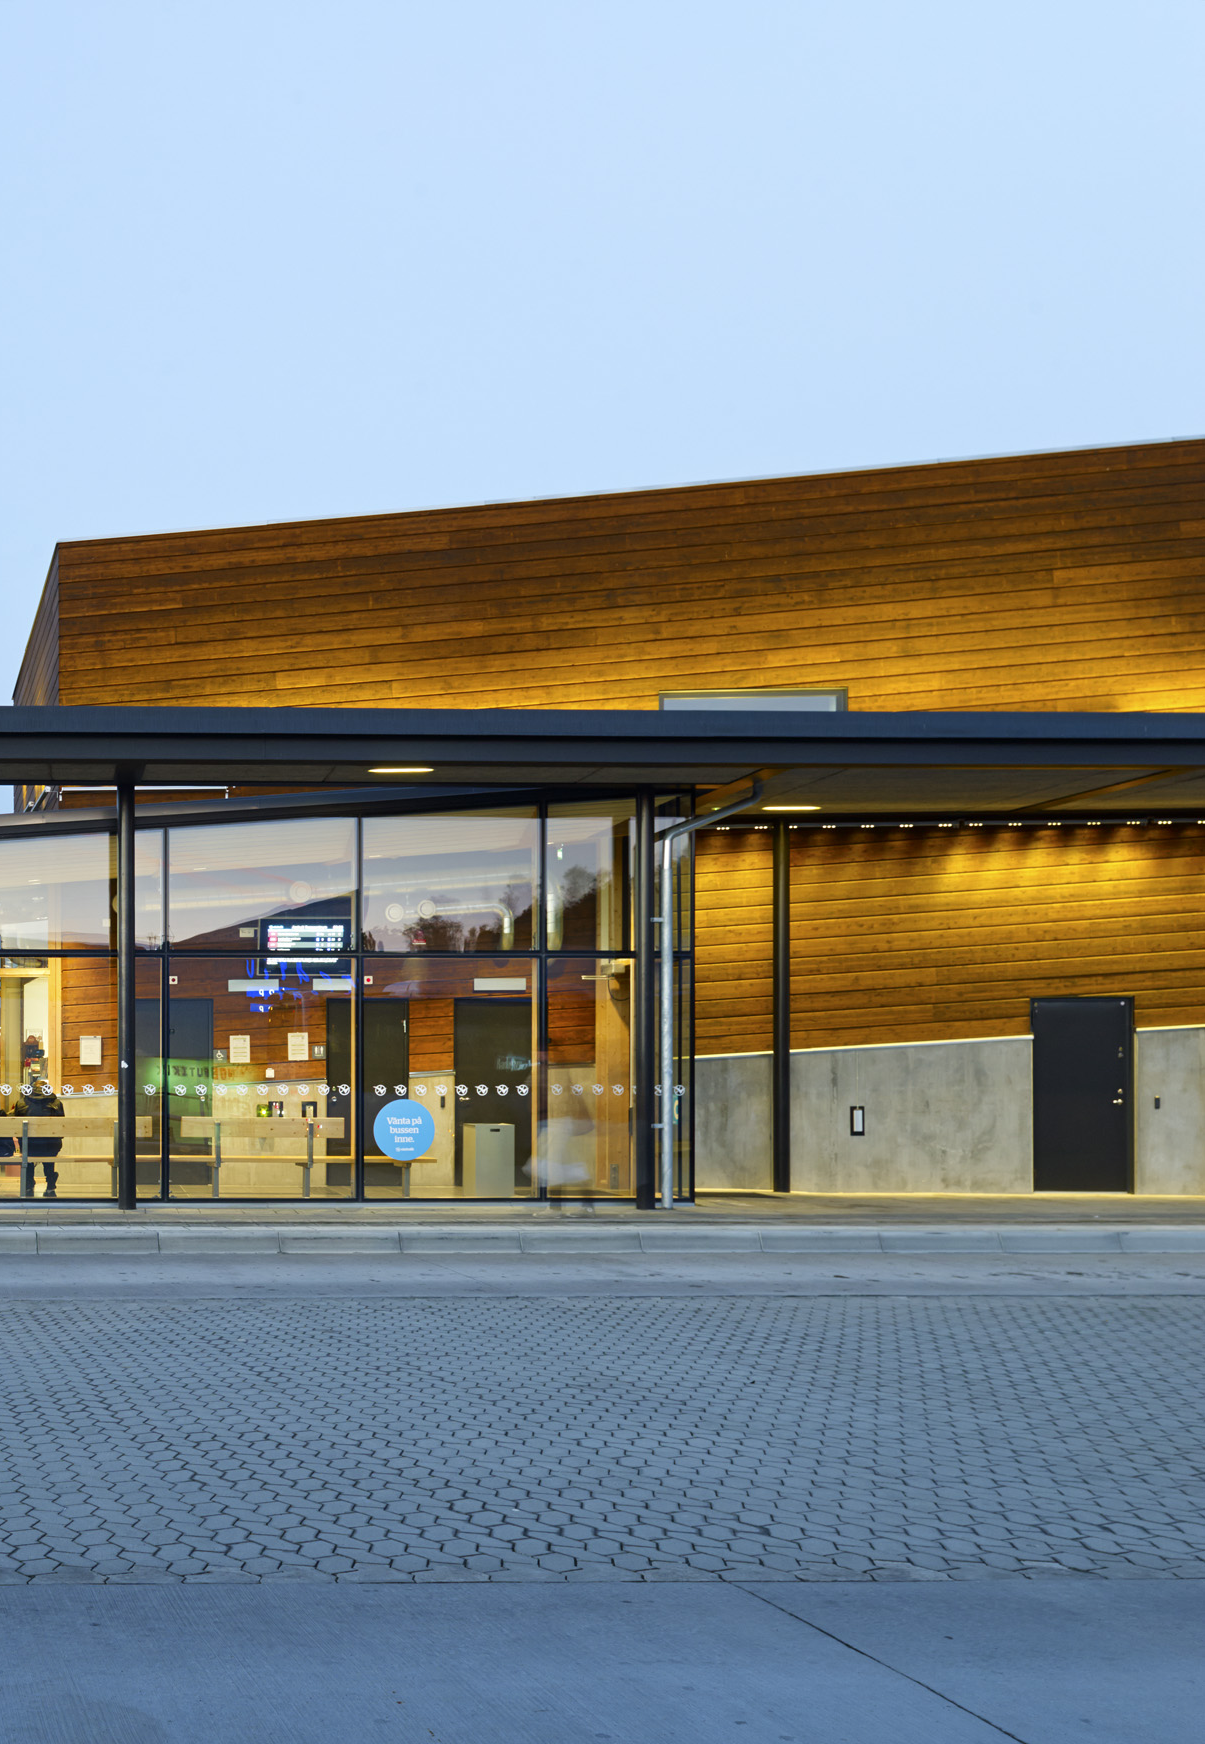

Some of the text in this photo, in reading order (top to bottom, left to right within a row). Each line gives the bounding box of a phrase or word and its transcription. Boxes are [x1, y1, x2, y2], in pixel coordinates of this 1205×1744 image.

[387, 1116, 422, 1126] Vänta på
[390, 1126, 419, 1134] bussen
[394, 1135, 415, 1143] inne.
